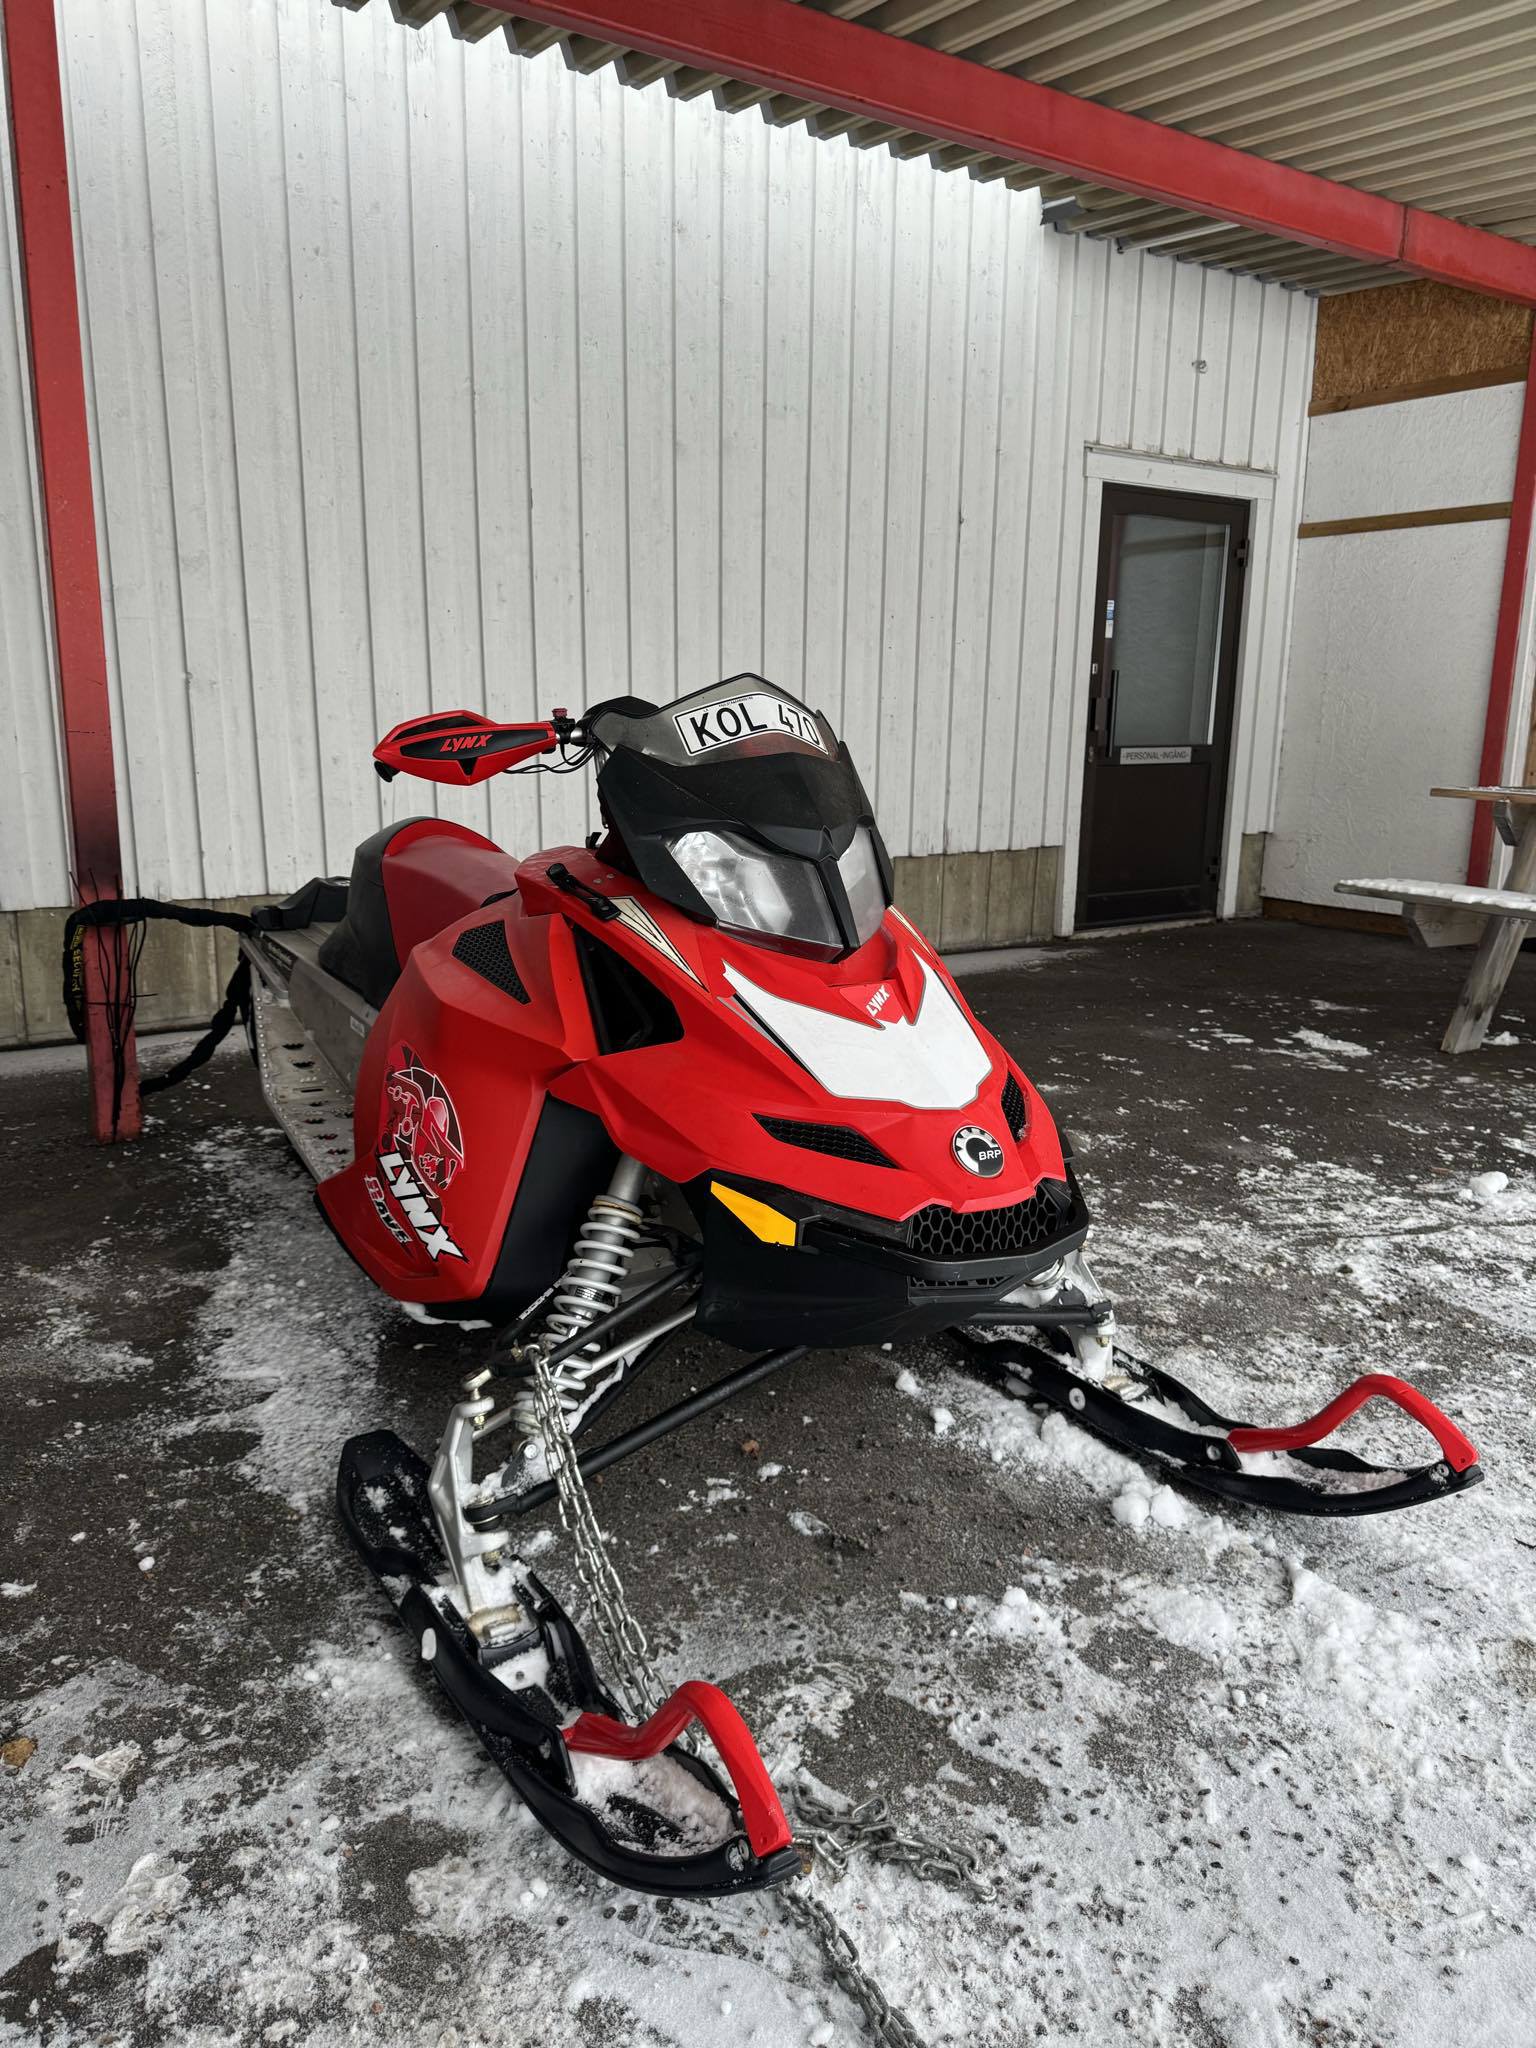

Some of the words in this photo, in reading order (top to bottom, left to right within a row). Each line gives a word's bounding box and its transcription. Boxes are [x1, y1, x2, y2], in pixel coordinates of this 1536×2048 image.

[690, 703, 768, 747] KOL
[778, 704, 820, 745] 470
[440, 734, 492, 752] LYNX
[865, 984, 890, 1017] LYNX
[978, 1149, 1001, 1160] BRP
[379, 1152, 465, 1260] LYNX
